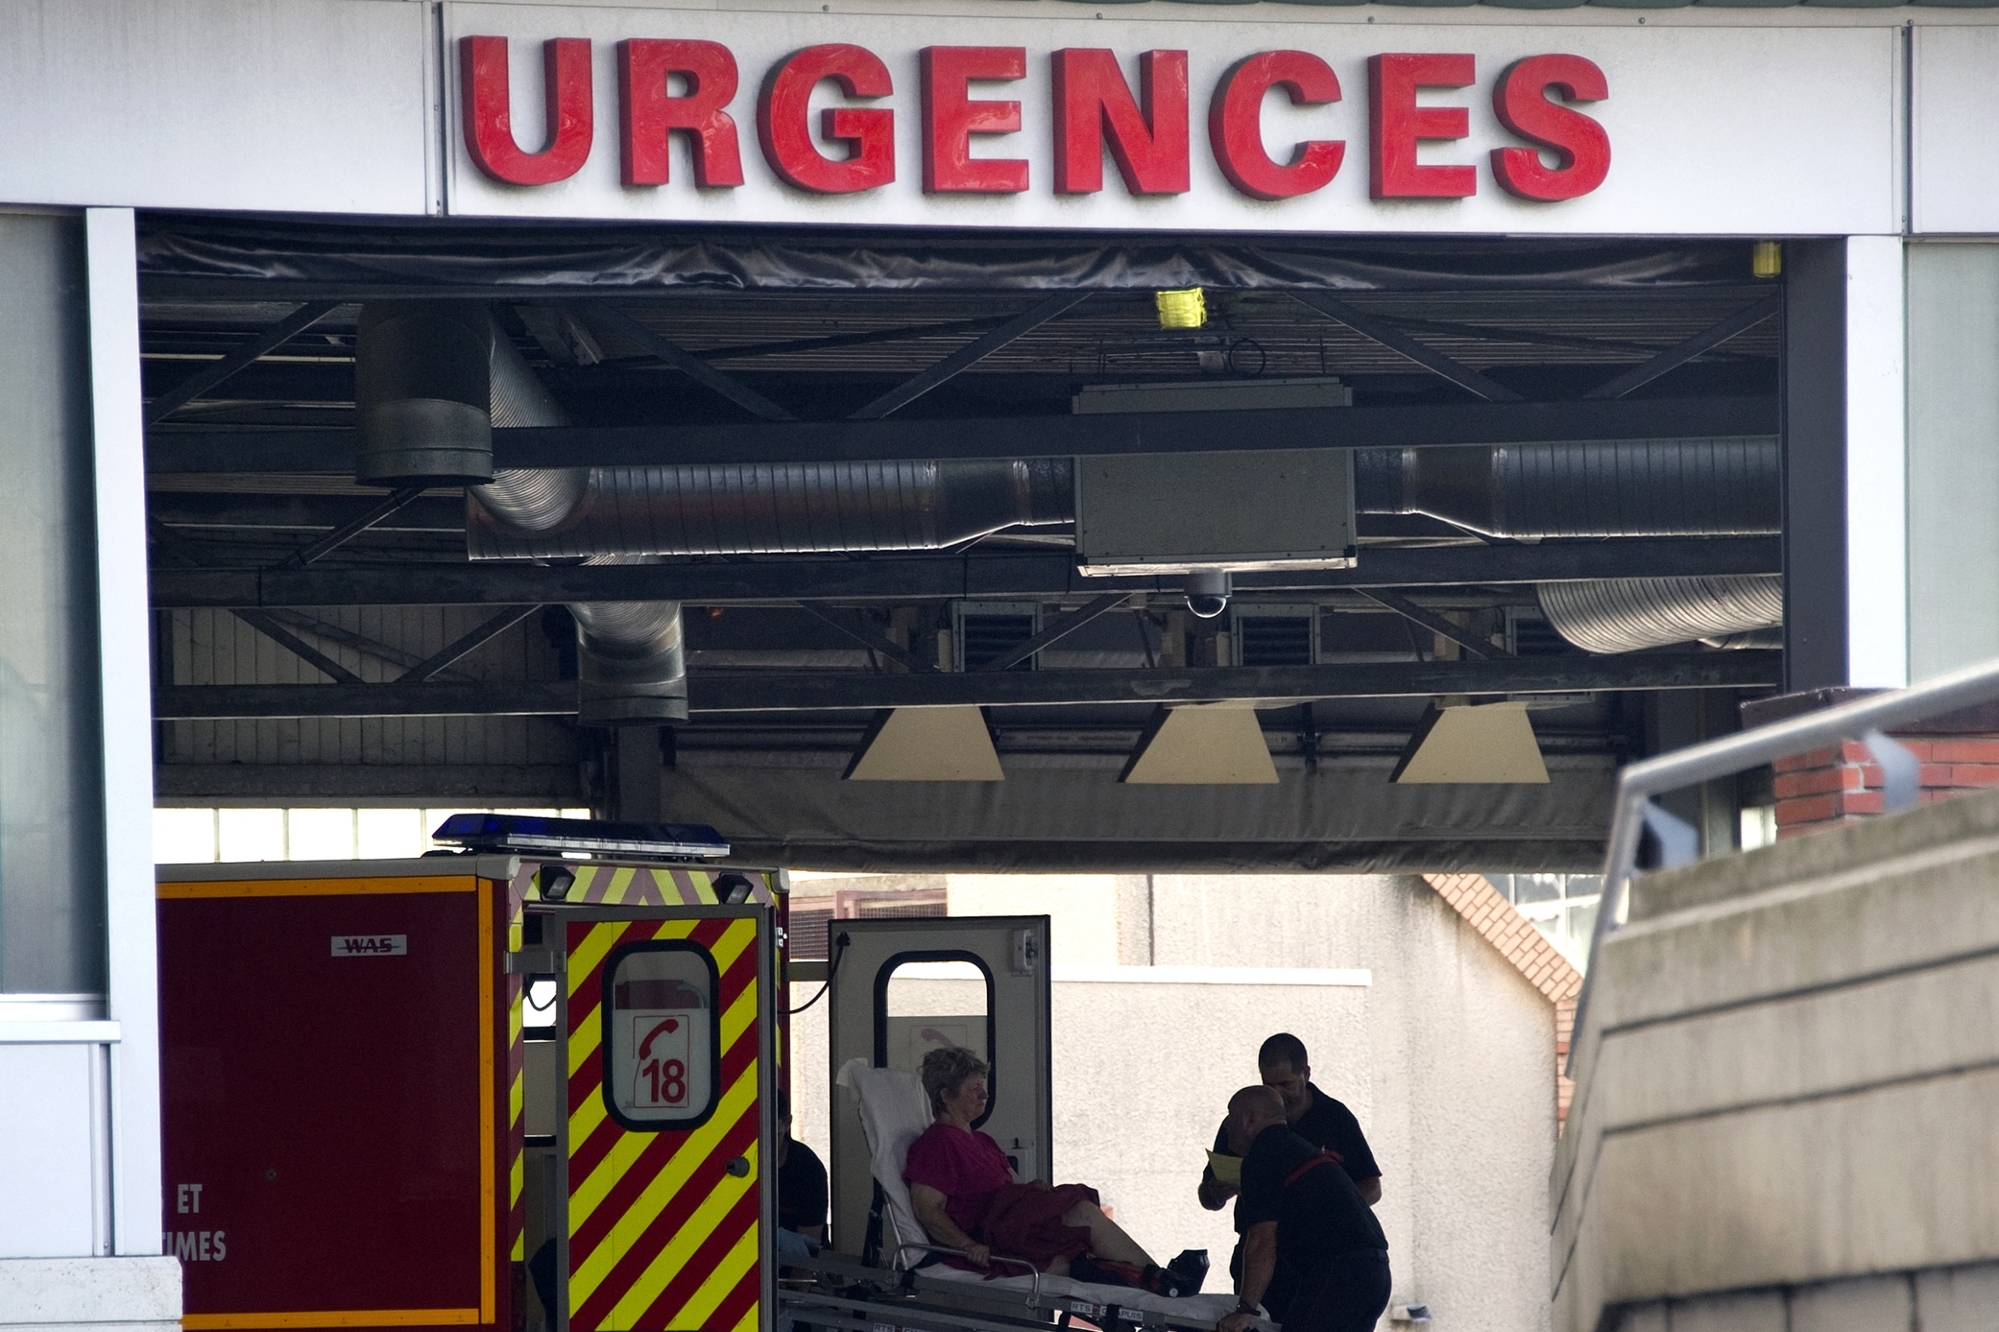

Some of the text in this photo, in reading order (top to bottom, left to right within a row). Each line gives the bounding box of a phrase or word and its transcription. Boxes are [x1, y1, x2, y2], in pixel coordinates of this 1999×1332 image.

[459, 35, 1611, 202] URGENCES
[344, 938, 392, 953] WAS
[642, 1058, 686, 1104] 18
[177, 1184, 202, 1213] ET
[1072, 1303, 1143, 1320] RTS CPUIS
